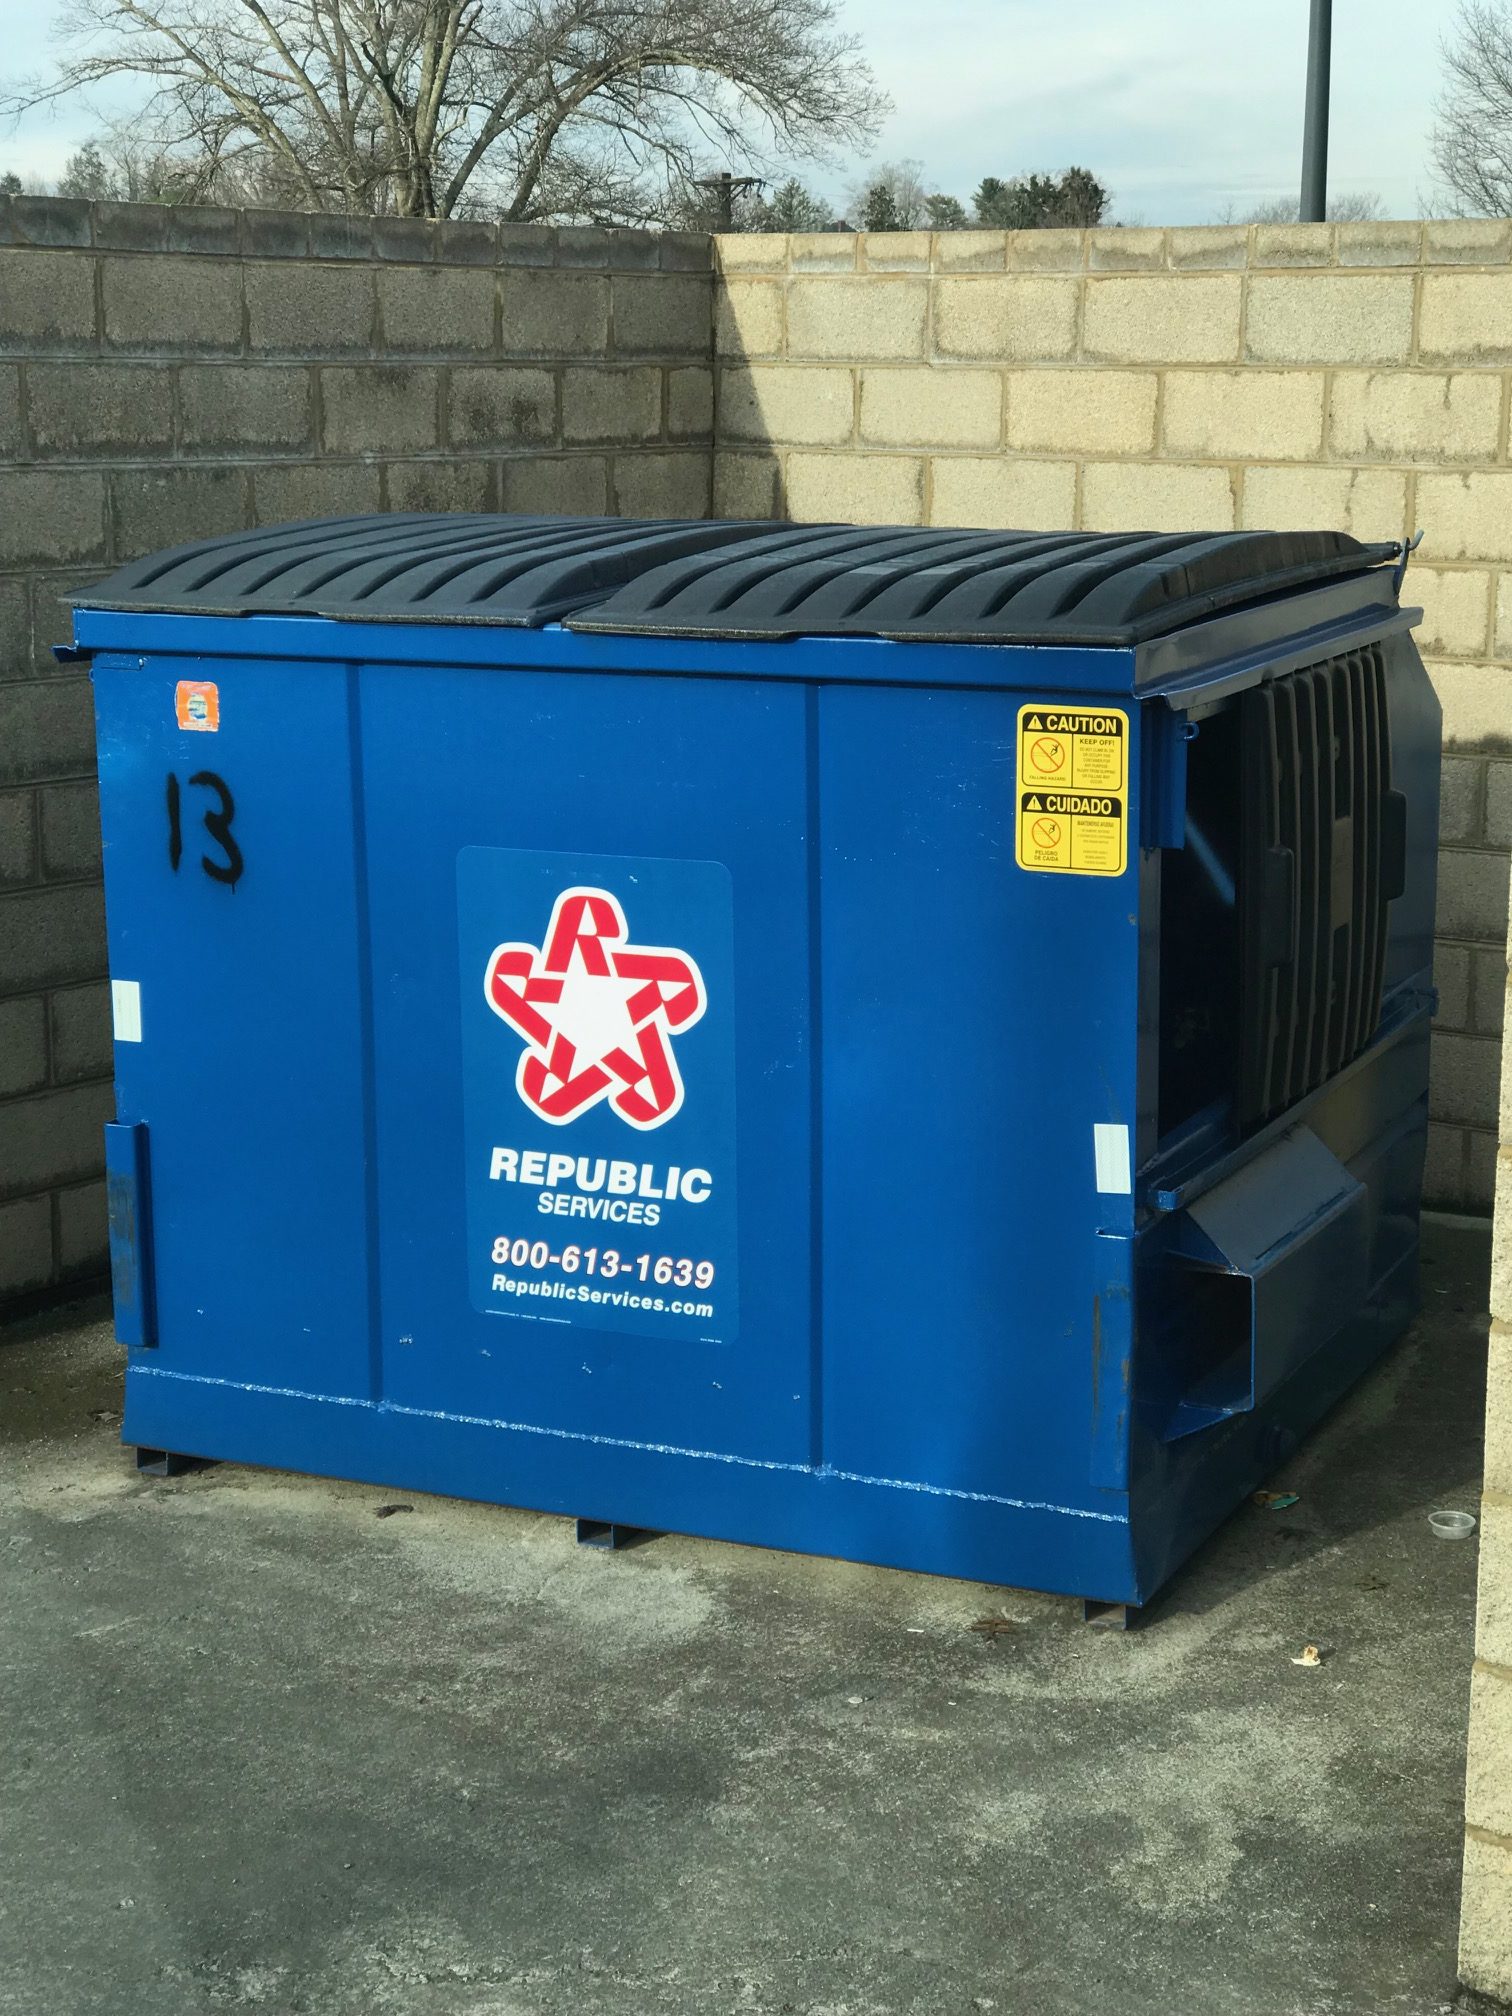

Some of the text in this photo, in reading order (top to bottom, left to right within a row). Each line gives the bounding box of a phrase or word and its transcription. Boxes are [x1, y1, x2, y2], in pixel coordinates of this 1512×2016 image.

[1046, 715, 1117, 734] CAUTION
[1046, 795, 1112, 815] CUIDADO
[167, 771, 244, 887] 13
[489, 1147, 713, 1204] REPUBLIC
[537, 1191, 661, 1227] SERVICES
[491, 1236, 715, 1290] 800-613-1639
[491, 1273, 714, 1318] RepublicServices.com
